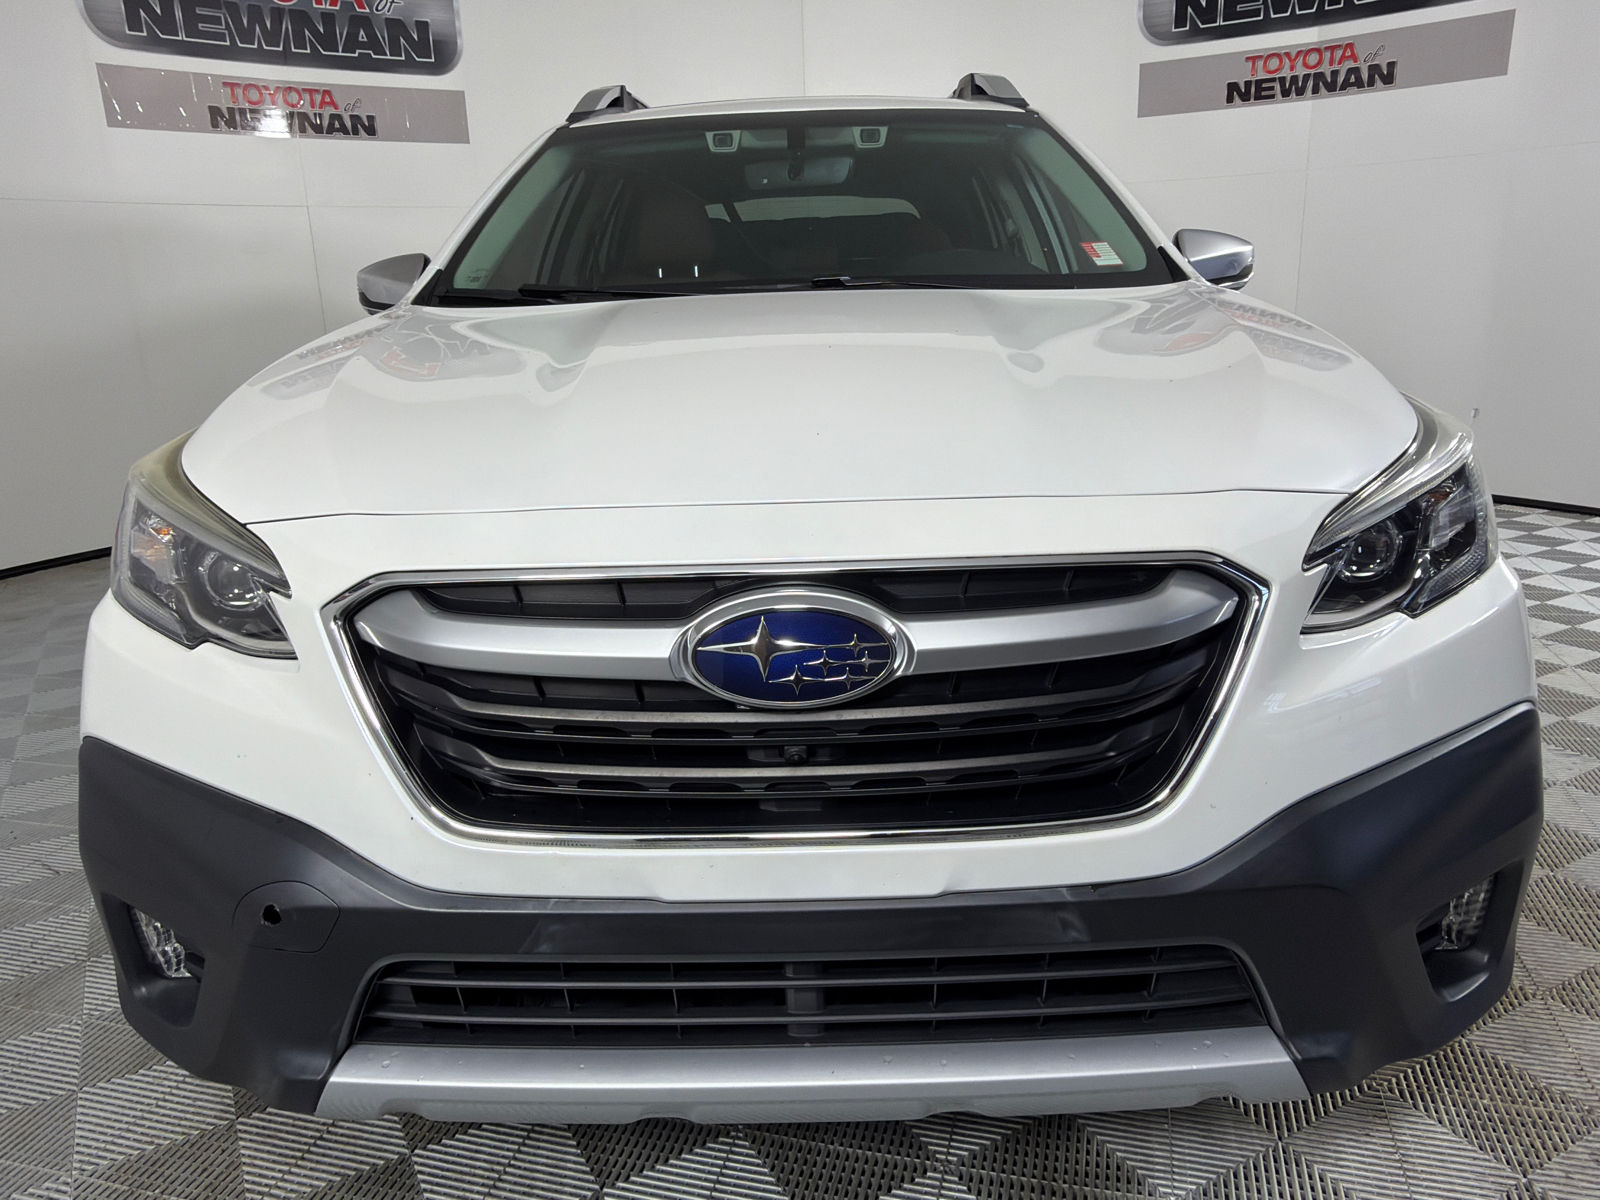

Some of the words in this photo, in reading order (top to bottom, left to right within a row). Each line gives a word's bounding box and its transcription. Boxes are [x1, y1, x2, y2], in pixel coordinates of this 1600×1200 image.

[122, 0, 435, 62] NEWNAN
[1245, 42, 1359, 77] TOYOTA
[1363, 44, 1385, 64] of
[222, 81, 340, 111] TOYOTA
[344, 98, 362, 112] of
[1225, 60, 1397, 104] NEWNAN
